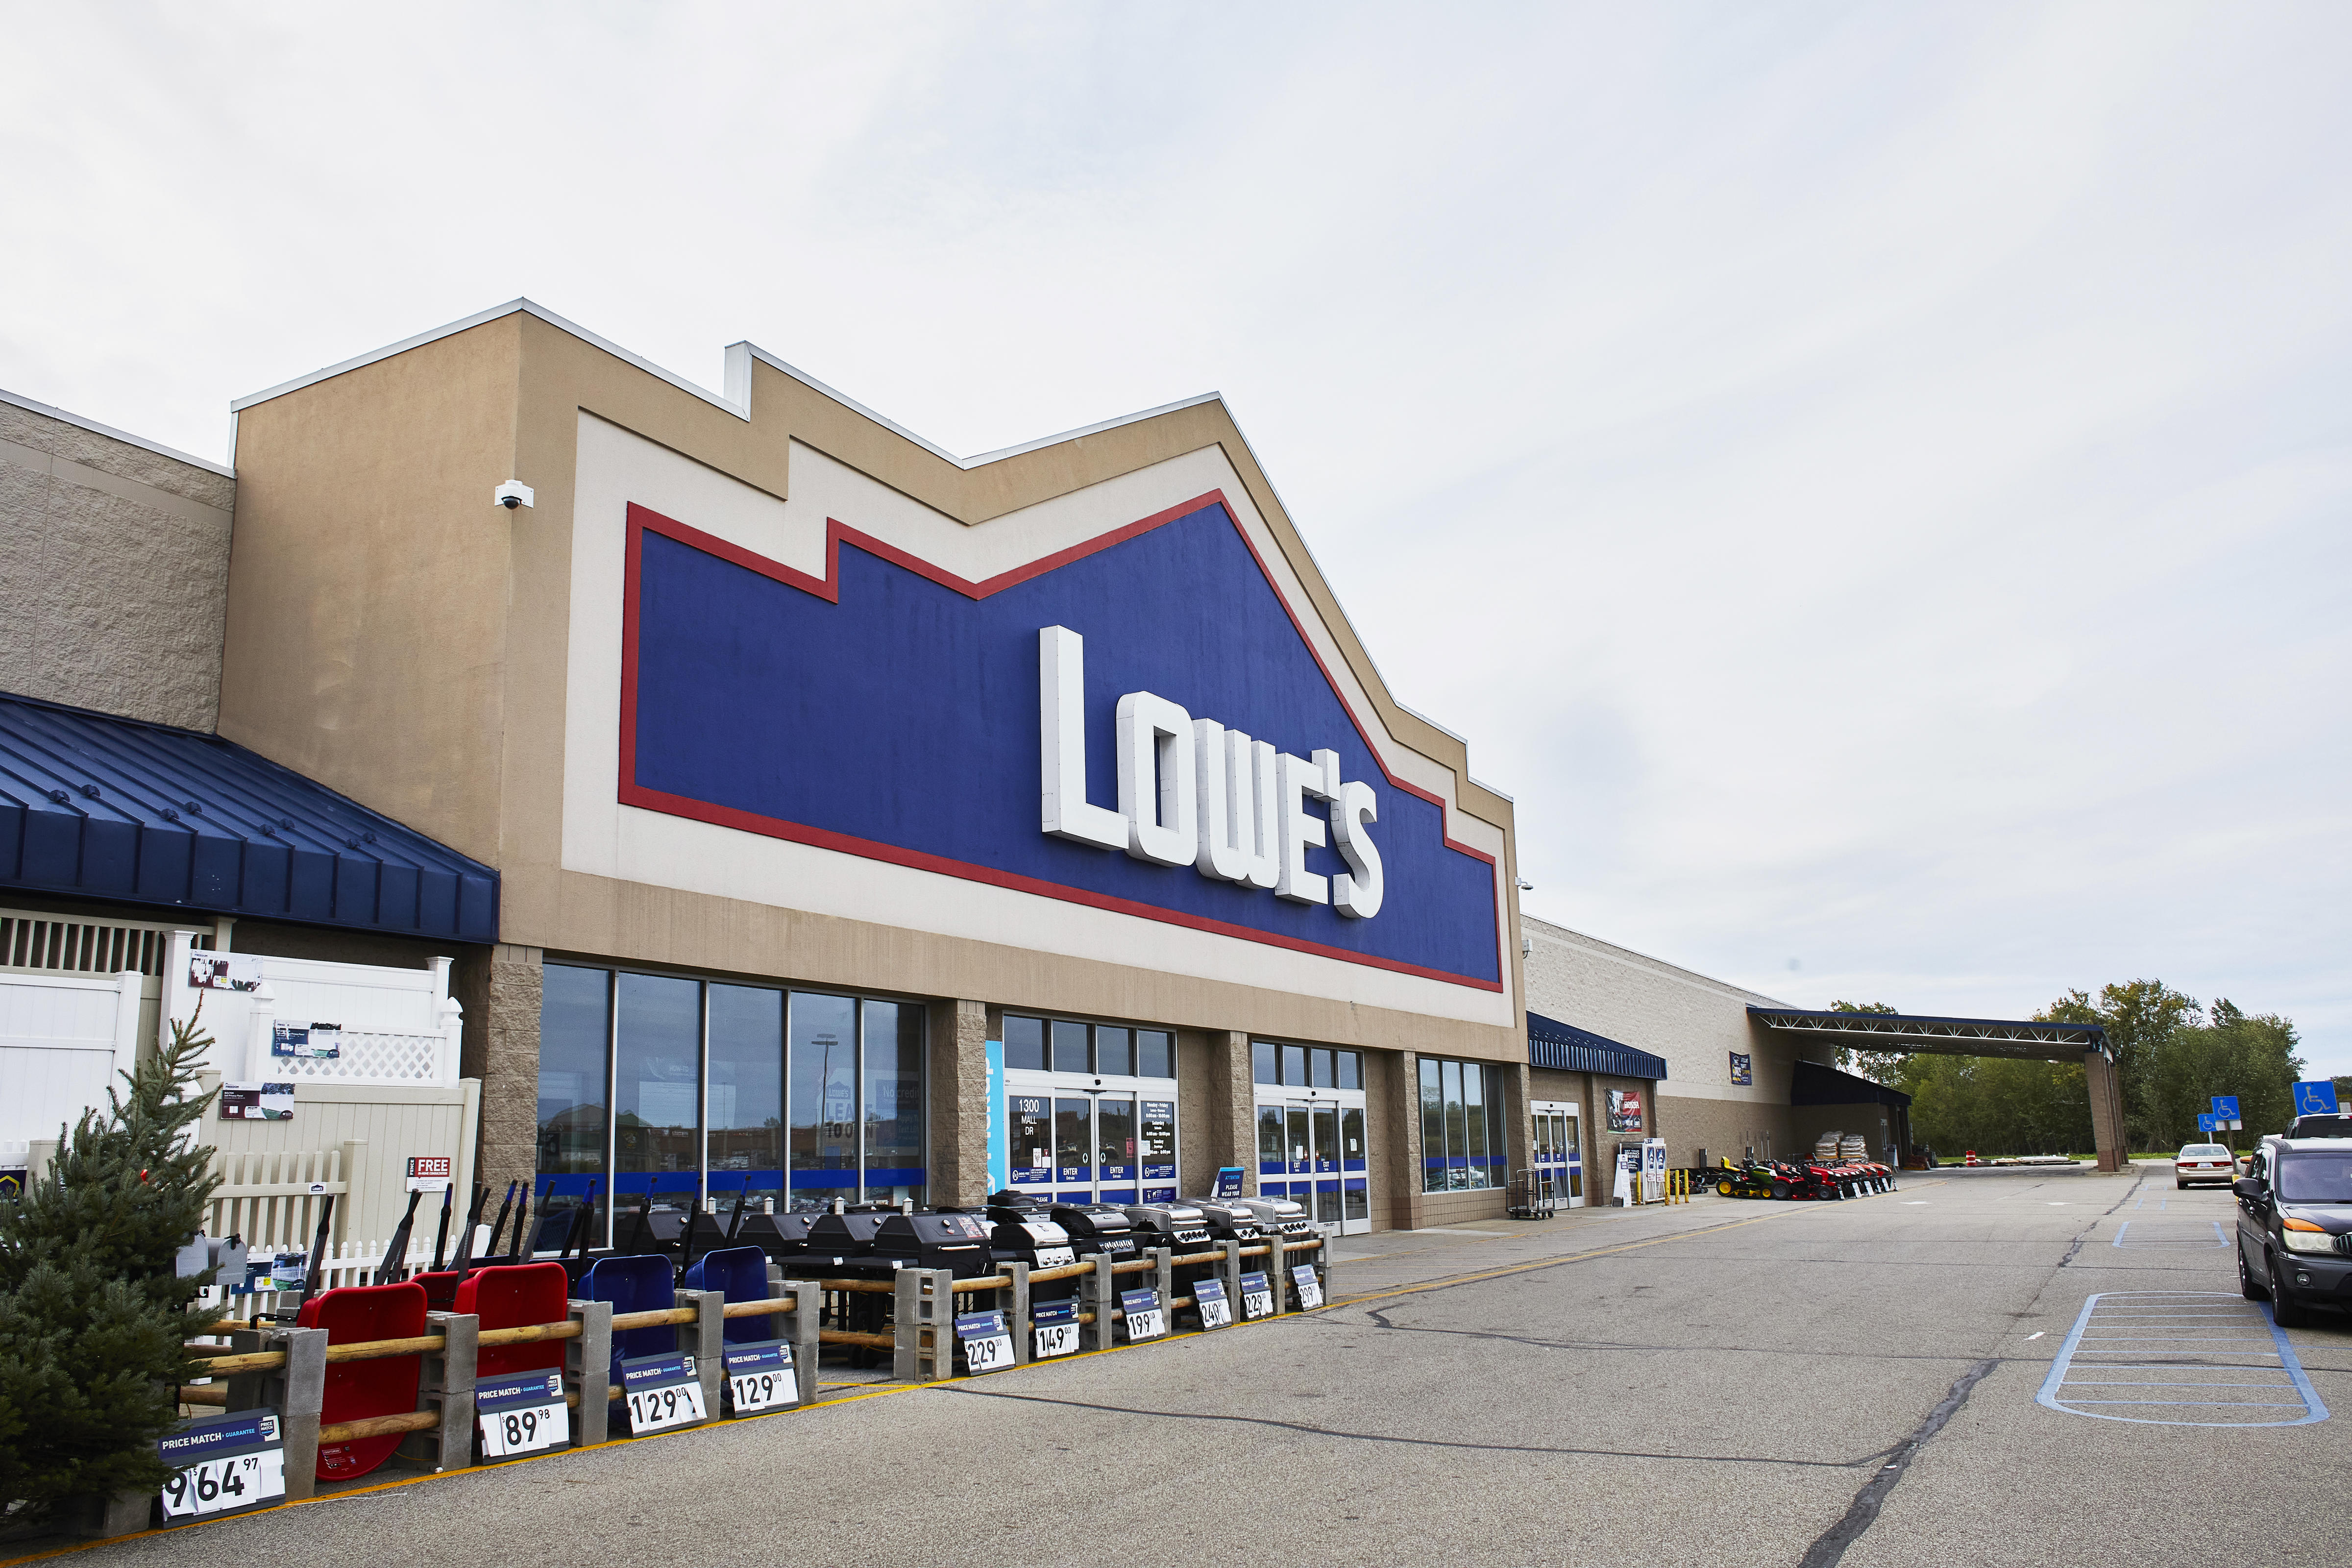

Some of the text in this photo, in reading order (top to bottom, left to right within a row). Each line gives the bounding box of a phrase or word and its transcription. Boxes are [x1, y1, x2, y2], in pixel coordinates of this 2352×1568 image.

[1039, 625, 1384, 918] LOWE'S
[1019, 1099, 1039, 1112] 1300
[1021, 1115, 1037, 1124] MALL
[1025, 1126, 1033, 1135] DR
[418, 1159, 448, 1172] FREE
[1300, 1286, 1313, 1303] 299
[1246, 1294, 1262, 1313] 229
[626, 1372, 642, 1380] PRICE
[643, 1368, 662, 1377] MATCH
[478, 1390, 498, 1400] PRICE
[499, 1387, 521, 1396] MATCH
[162, 1428, 255, 1450] PRICE MATCH GUARANTEE
